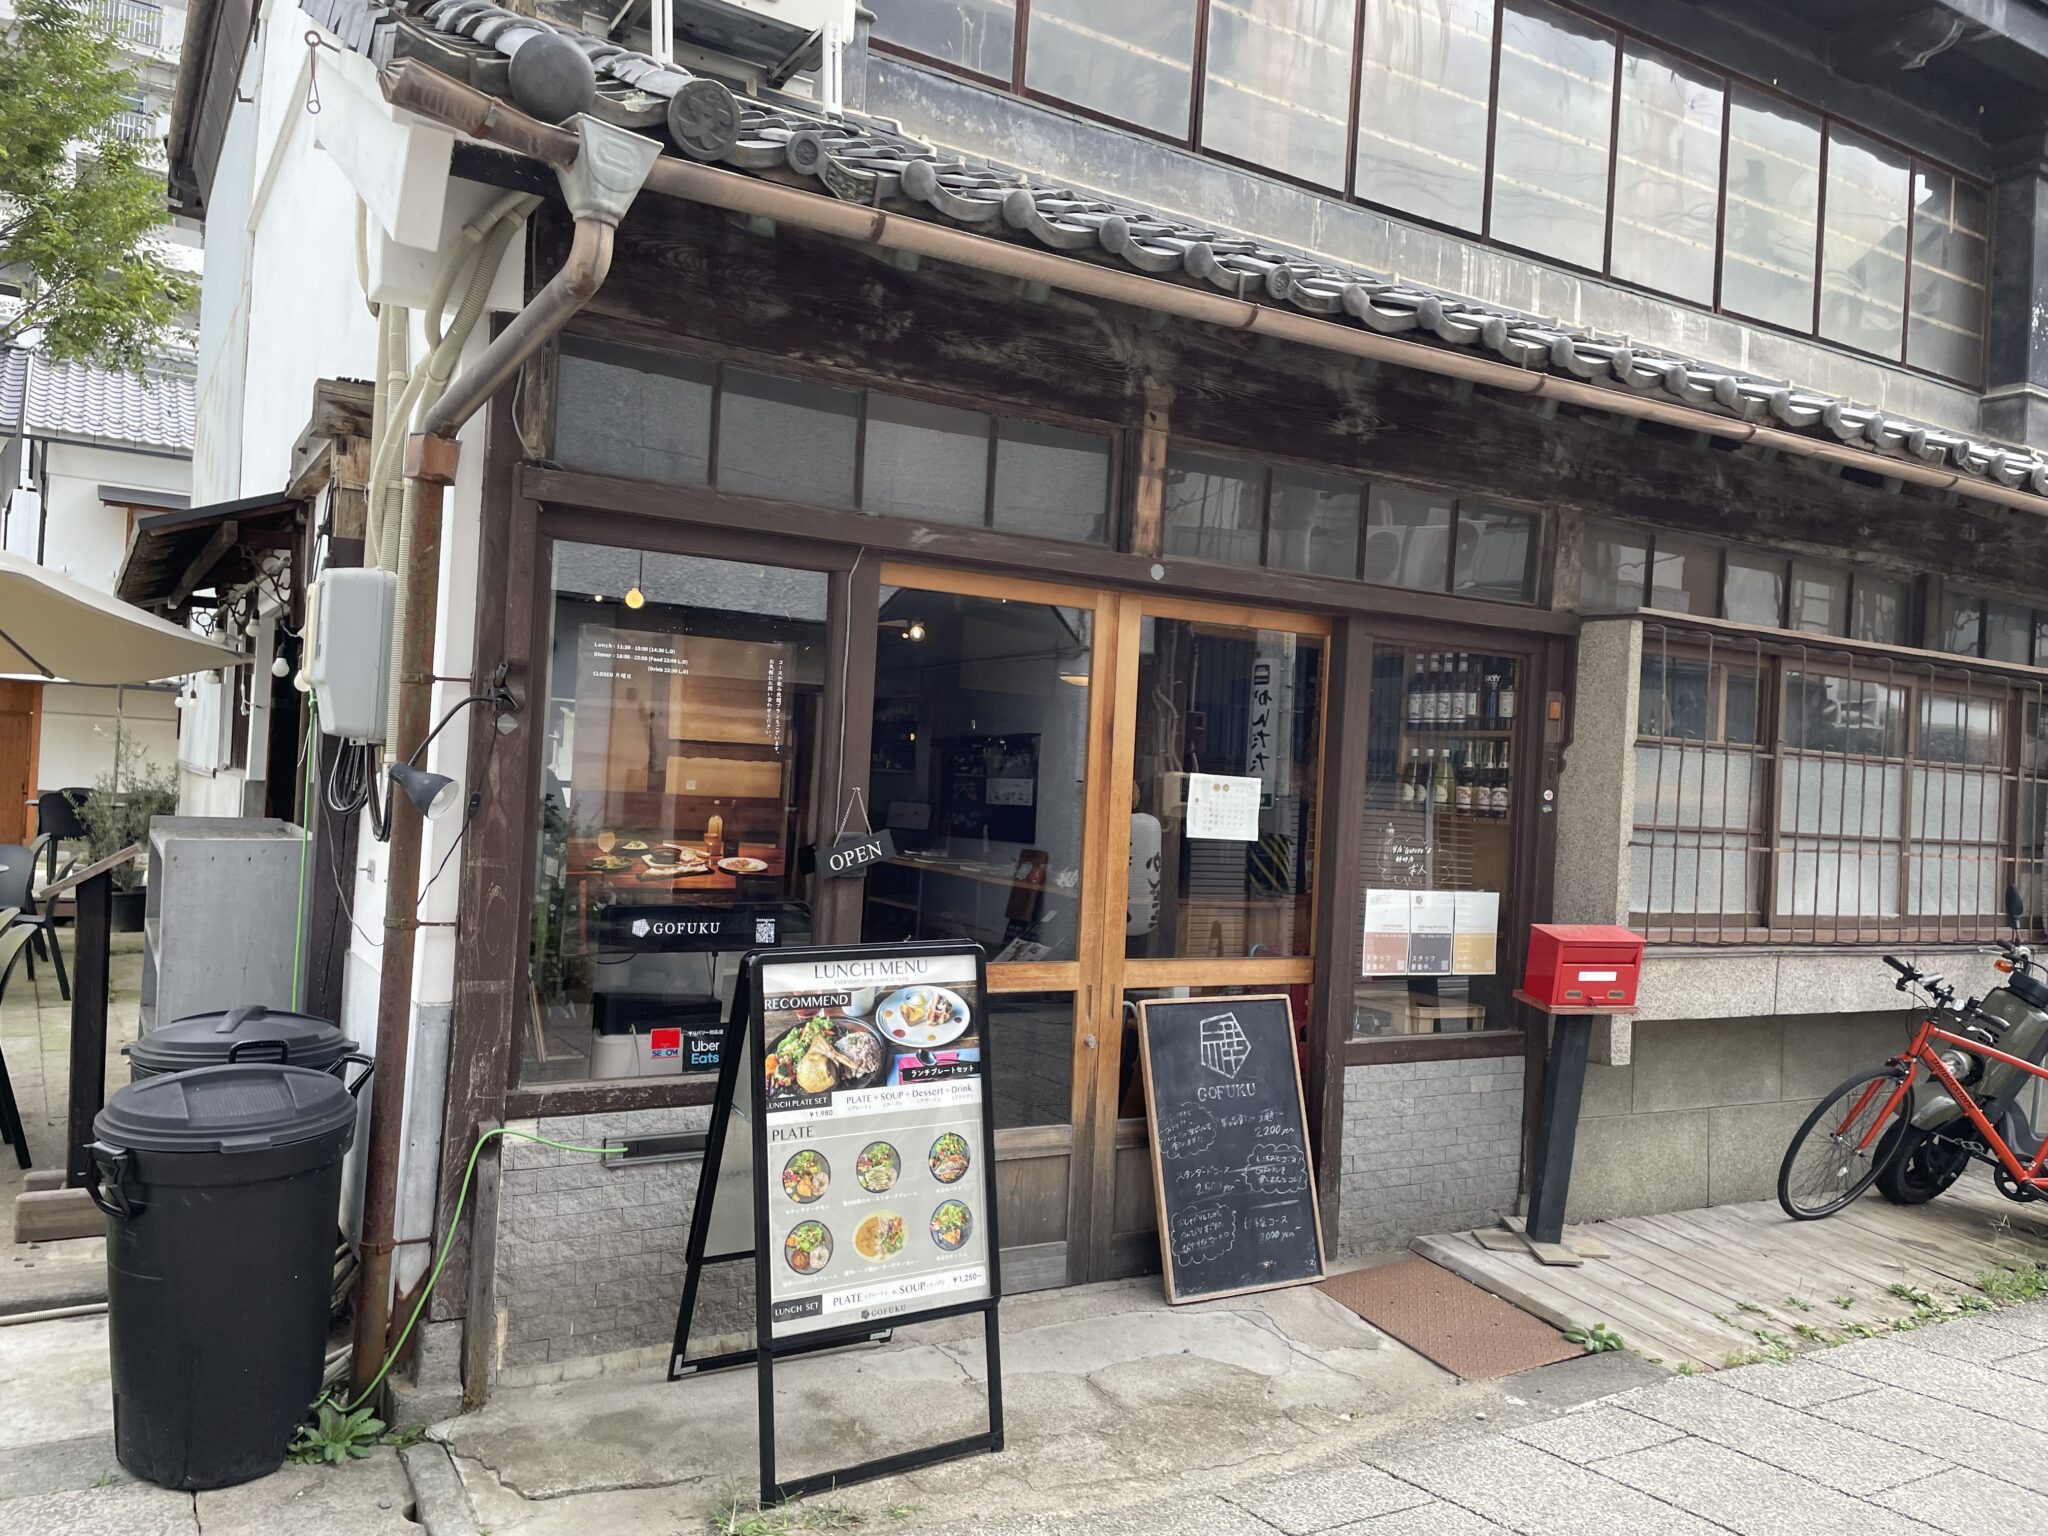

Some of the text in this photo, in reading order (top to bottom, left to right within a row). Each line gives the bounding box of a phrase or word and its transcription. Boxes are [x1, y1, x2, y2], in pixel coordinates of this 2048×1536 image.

[593, 651, 612, 659] Dinner
[615, 672, 632, 680] 月曜日
[830, 840, 882, 871] OPEN
[653, 922, 720, 935] GOFUKU
[1411, 955, 1435, 963] スタッフ
[814, 960, 928, 979] LUNCH MENU
[764, 994, 849, 1010] RECOMMEND
[691, 1041, 720, 1052] Uber
[691, 1052, 720, 1064] Eats
[911, 1065, 975, 1077] ランチプレートセット
[846, 1094, 871, 1105] PLATE
[880, 1091, 904, 1101] SOUP
[912, 1087, 943, 1098] Dessert
[951, 1084, 973, 1093] Drink
[1198, 1083, 1256, 1101] GOFUKU
[792, 1098, 814, 1107] PLATE
[814, 1096, 827, 1104] SET
[772, 1126, 814, 1141] PLATE
[833, 1293, 863, 1306] PLATE
[899, 1281, 926, 1295] SOUP
[774, 1301, 819, 1316] LUNCH SET
[871, 1303, 906, 1317] GOFUKU
